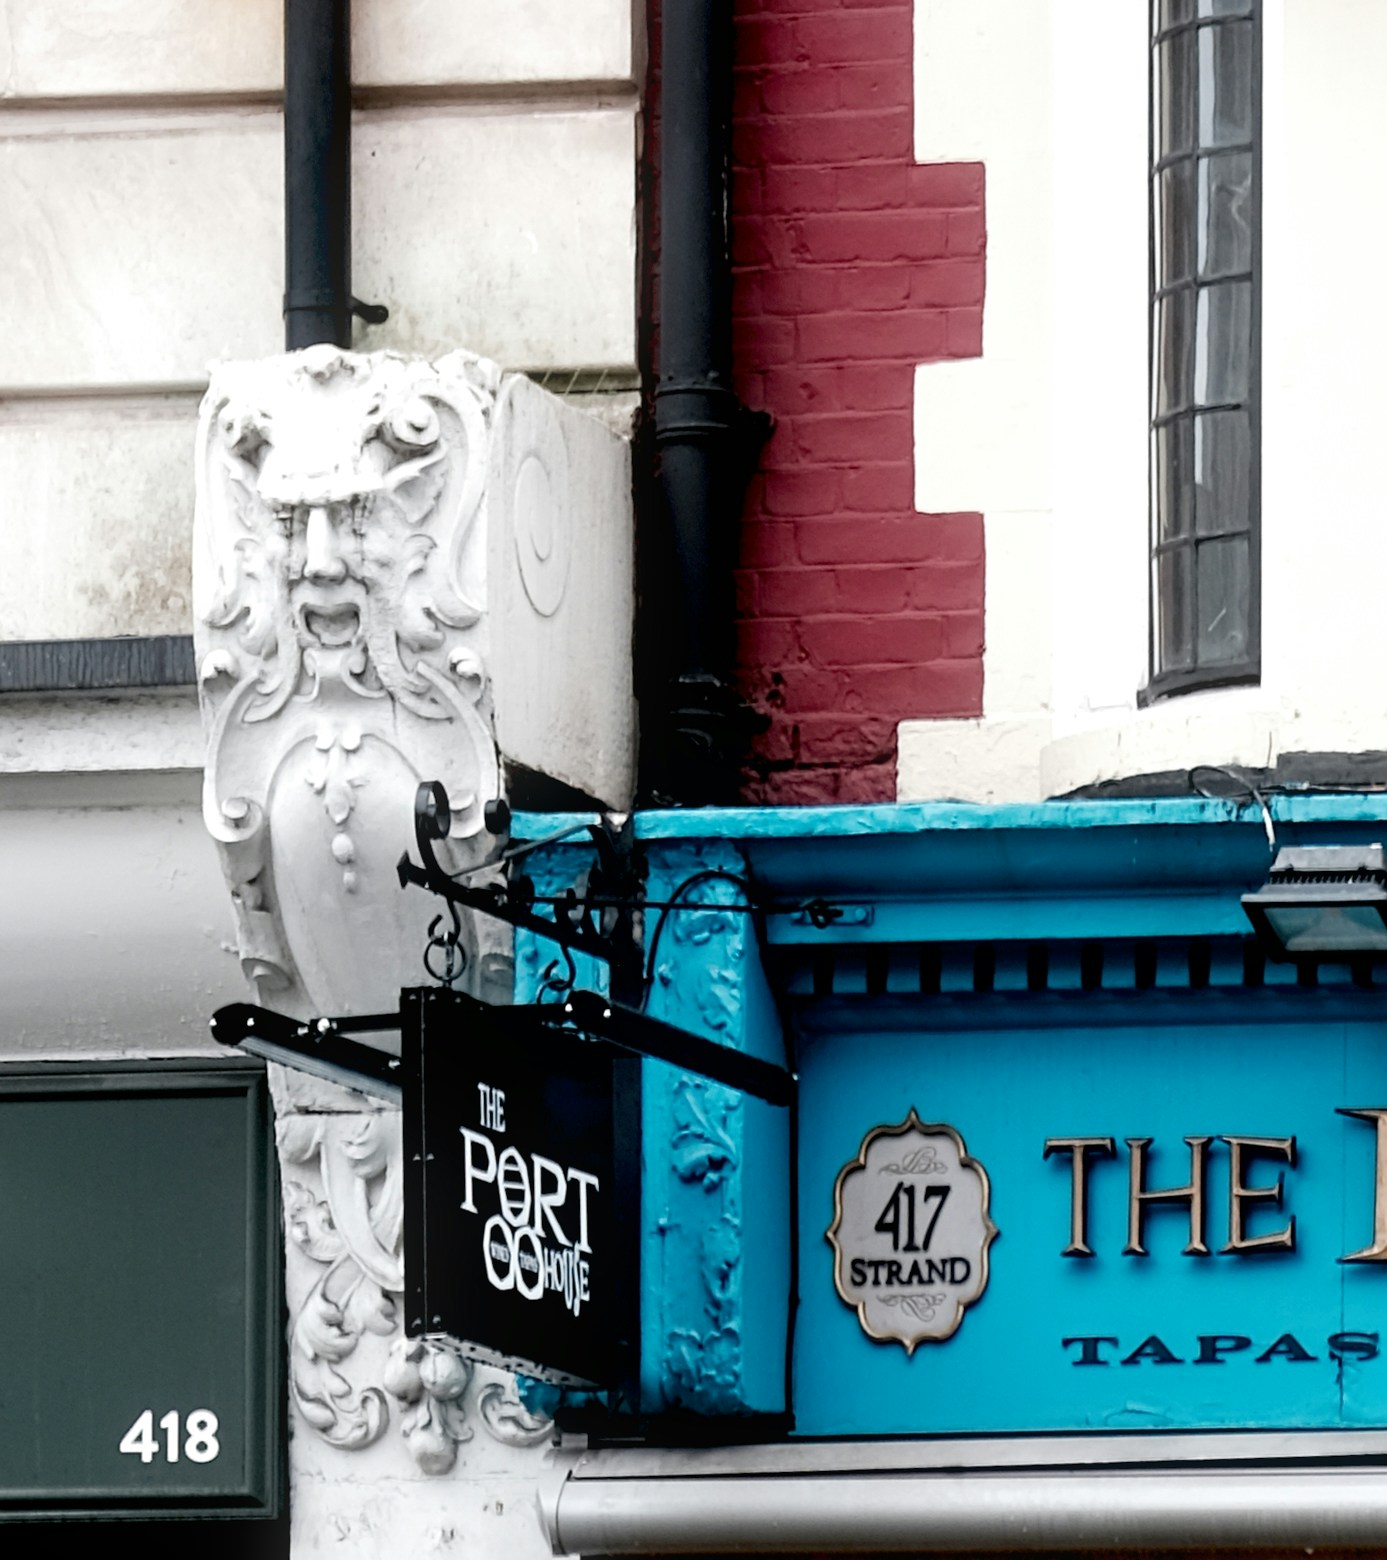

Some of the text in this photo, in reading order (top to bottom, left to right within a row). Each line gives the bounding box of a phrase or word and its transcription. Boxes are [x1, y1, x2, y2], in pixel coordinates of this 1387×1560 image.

[477, 1082, 506, 1133] THE
[459, 1126, 600, 1254] PORT
[875, 1181, 952, 1252] 417
[1043, 1134, 1297, 1258] THE
[544, 1240, 591, 1317] HOUSE
[851, 1256, 971, 1287] STRAND
[1061, 1332, 1380, 1367] TAPAS
[119, 1408, 220, 1464] 418
